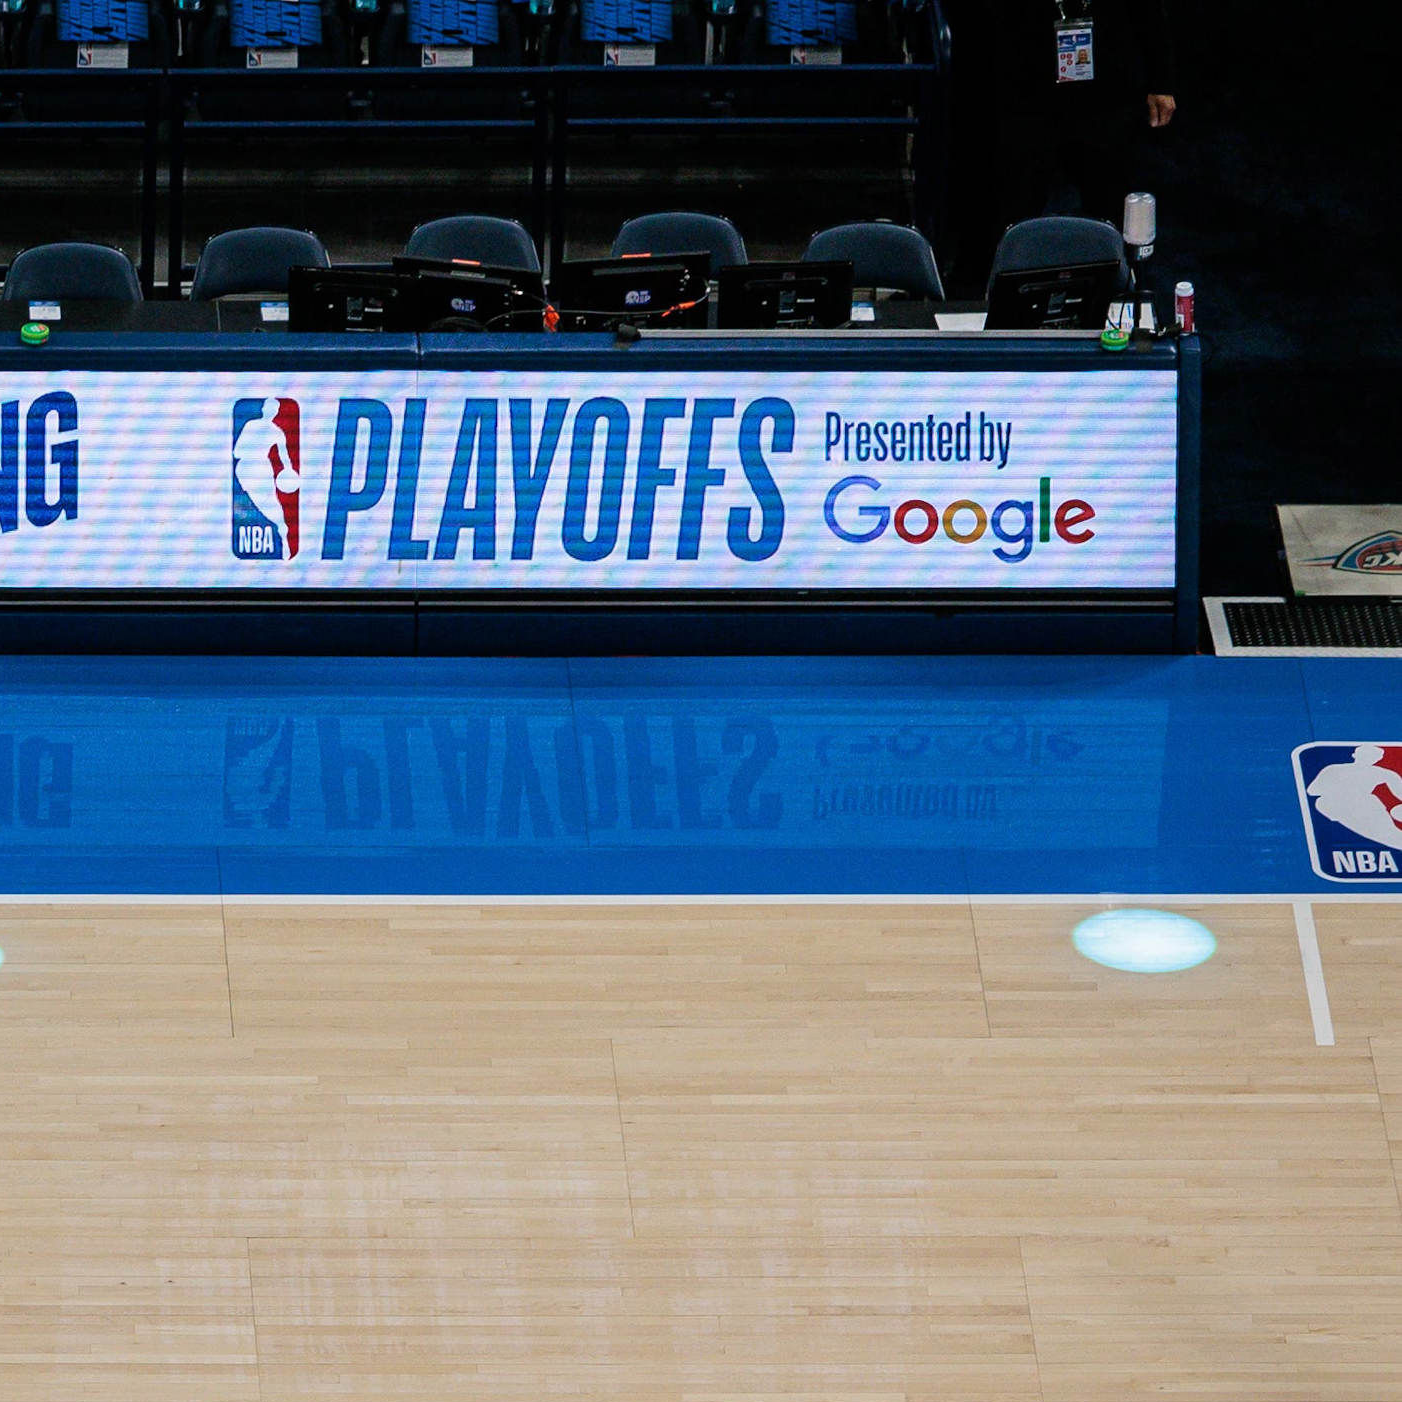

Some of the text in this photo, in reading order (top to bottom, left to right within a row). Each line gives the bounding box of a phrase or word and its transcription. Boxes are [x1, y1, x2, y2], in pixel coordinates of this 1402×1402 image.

[824, 411, 1012, 470] Presented by
[321, 396, 796, 561] PLAYOFFS
[238, 525, 275, 554] NBA
[824, 475, 1096, 565] Google
[1332, 850, 1399, 874] NBA
